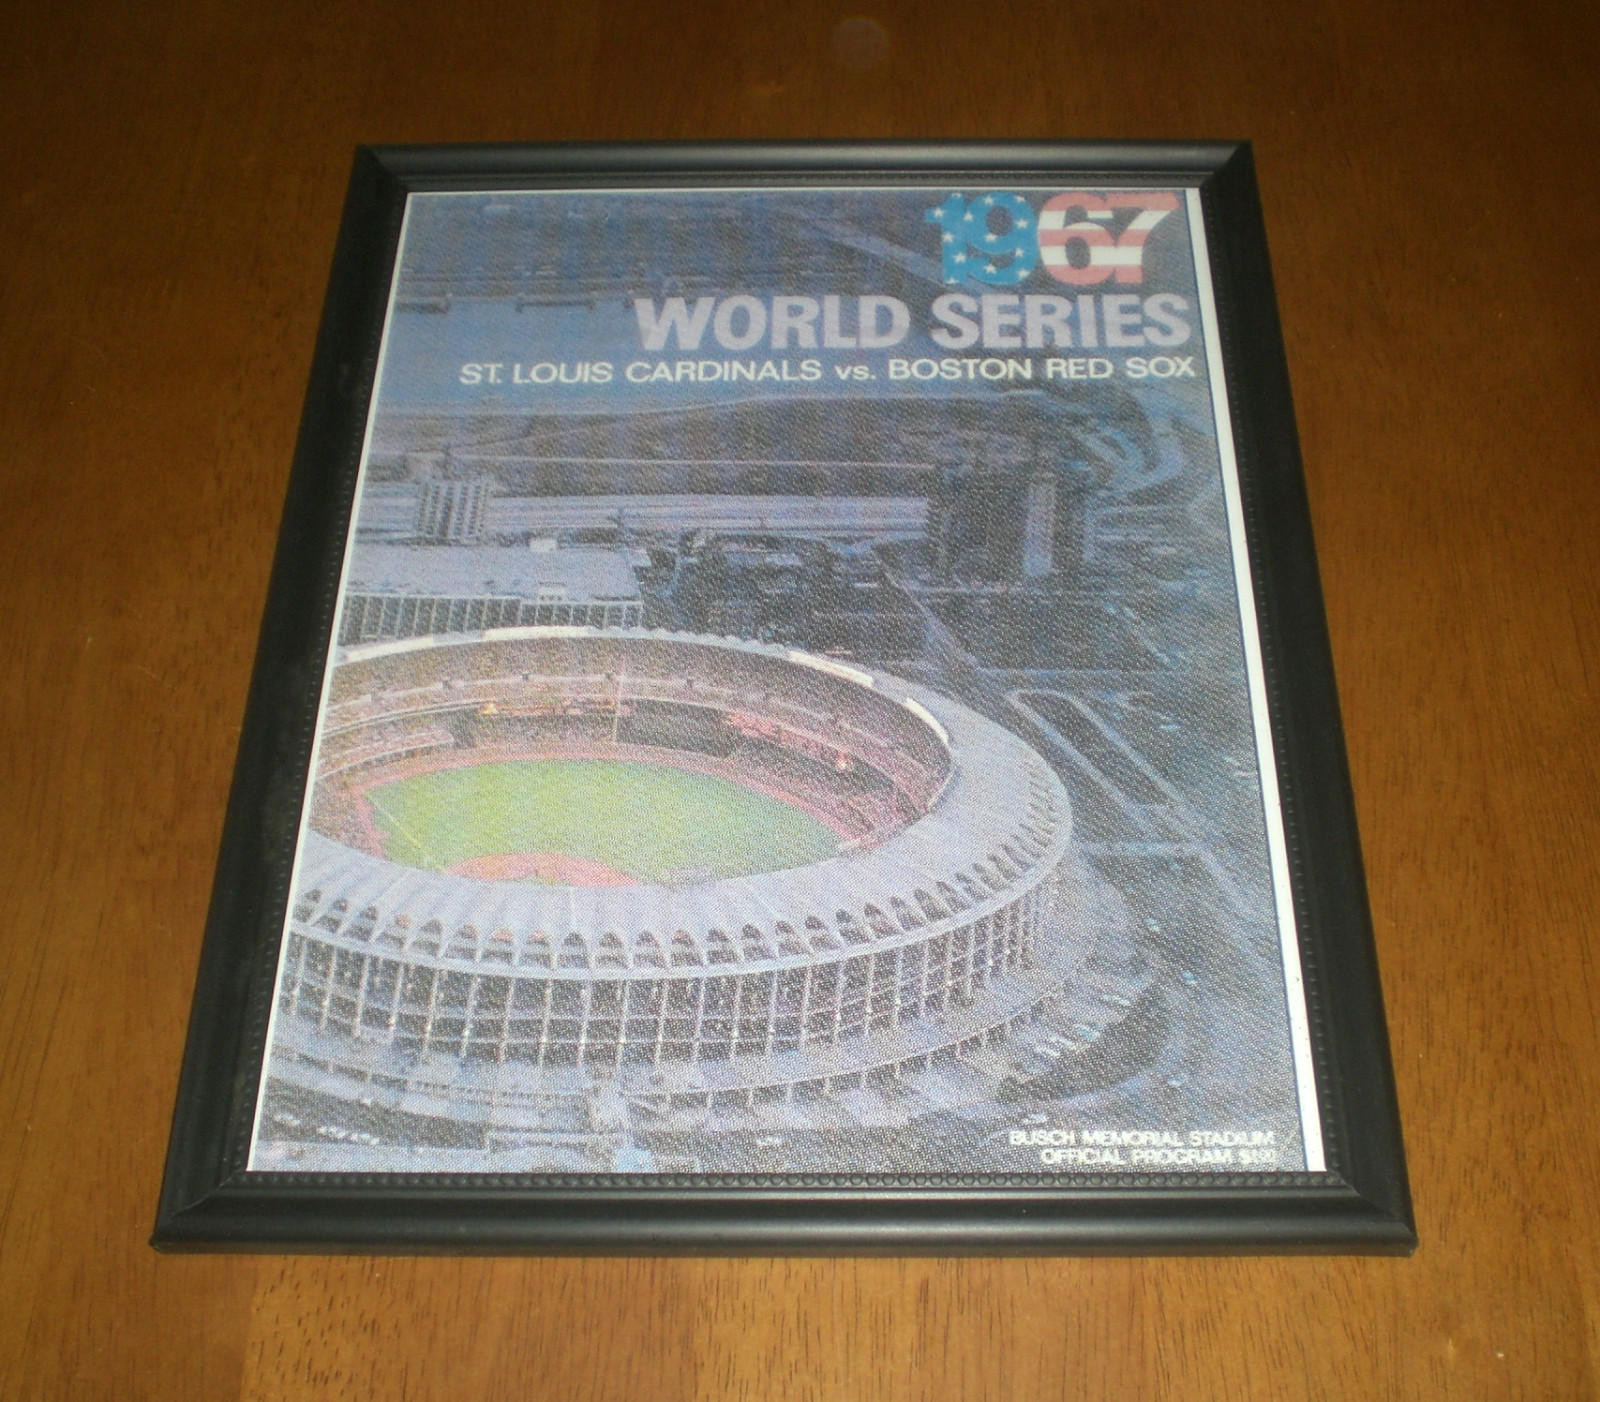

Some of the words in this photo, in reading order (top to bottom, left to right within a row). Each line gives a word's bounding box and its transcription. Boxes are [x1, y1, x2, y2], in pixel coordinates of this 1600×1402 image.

[925, 191, 1180, 286] 1967
[634, 294, 910, 351] WORLD
[930, 293, 1192, 349] SERIES
[459, 363, 503, 385] ST.
[512, 362, 613, 385] LOUIS
[625, 358, 822, 383] CARDINALS
[835, 364, 876, 381] vs.
[888, 358, 1032, 382] BOSTON
[1047, 357, 1114, 380] RED
[1125, 356, 1196, 379] SOX
[1009, 1130, 1075, 1146] BUSCH
[1081, 1130, 1185, 1147] MEMORIAL
[1189, 1129, 1276, 1147] STADIUM
[1040, 1148, 1126, 1165] OFFICIAL
[1132, 1148, 1233, 1165] PROGRAM
